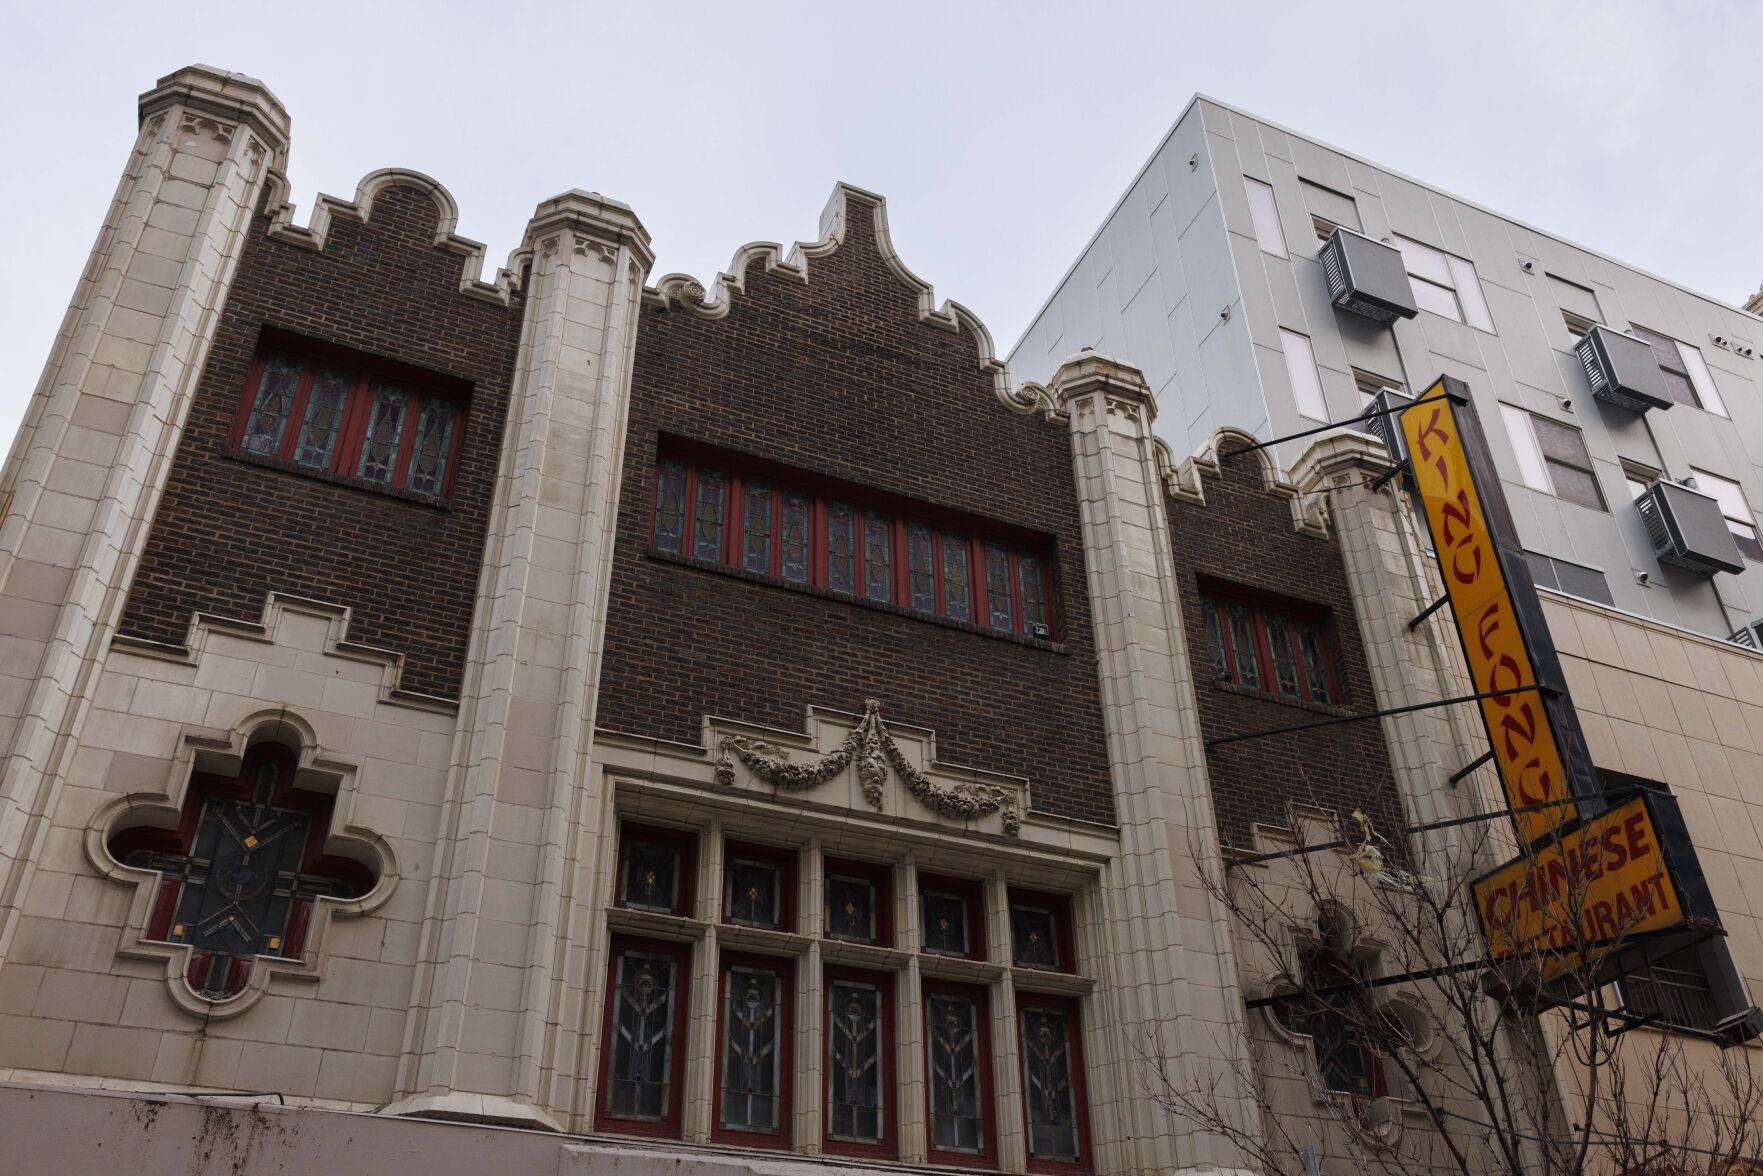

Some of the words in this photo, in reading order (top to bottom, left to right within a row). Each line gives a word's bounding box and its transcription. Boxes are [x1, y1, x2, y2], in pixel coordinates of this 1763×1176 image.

[1416, 408, 1481, 584] KING
[1478, 603, 1550, 813] FONG
[1485, 812, 1650, 931] CHINESE
[1496, 872, 1669, 964] TAURANT
